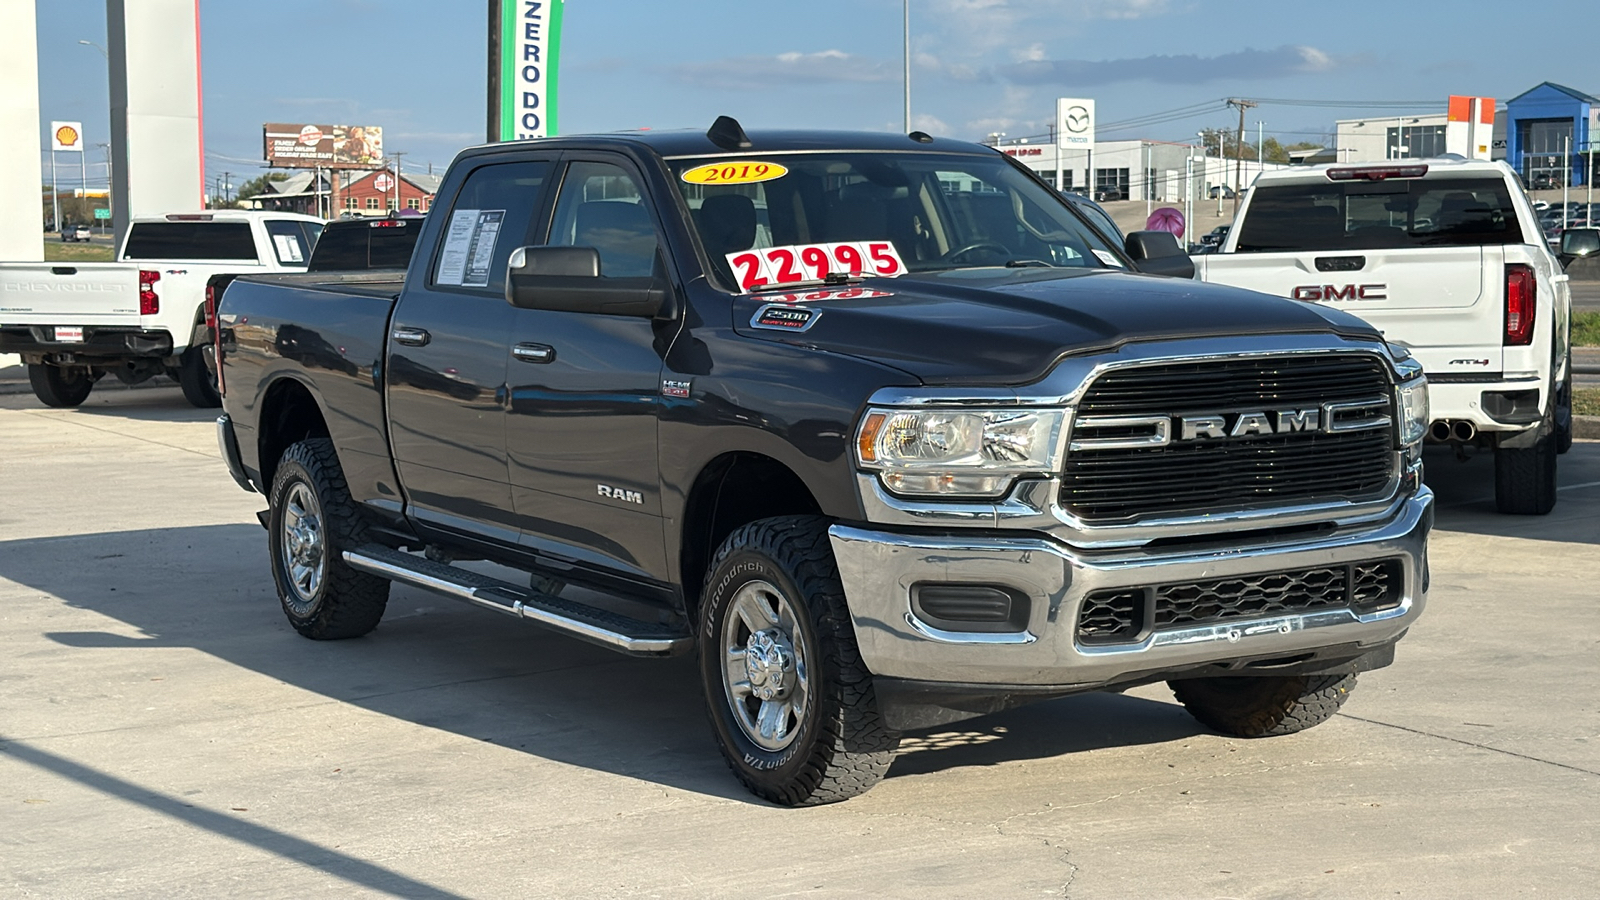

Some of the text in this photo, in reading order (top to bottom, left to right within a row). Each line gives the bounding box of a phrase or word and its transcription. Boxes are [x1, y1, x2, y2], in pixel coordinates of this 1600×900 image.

[519, 1, 543, 140] ZERO DO
[704, 164, 770, 182] 2019
[732, 243, 899, 291] 22995
[4, 282, 127, 293] CHEVROLET
[1291, 283, 1388, 301] GMC
[765, 309, 810, 321] 2500
[1449, 358, 1490, 367] AT4
[663, 379, 691, 389] HEMI
[1181, 408, 1320, 441] RAM
[596, 483, 644, 505] RAM
[705, 561, 764, 639] BFGoodrich
[743, 752, 764, 771] T/A
